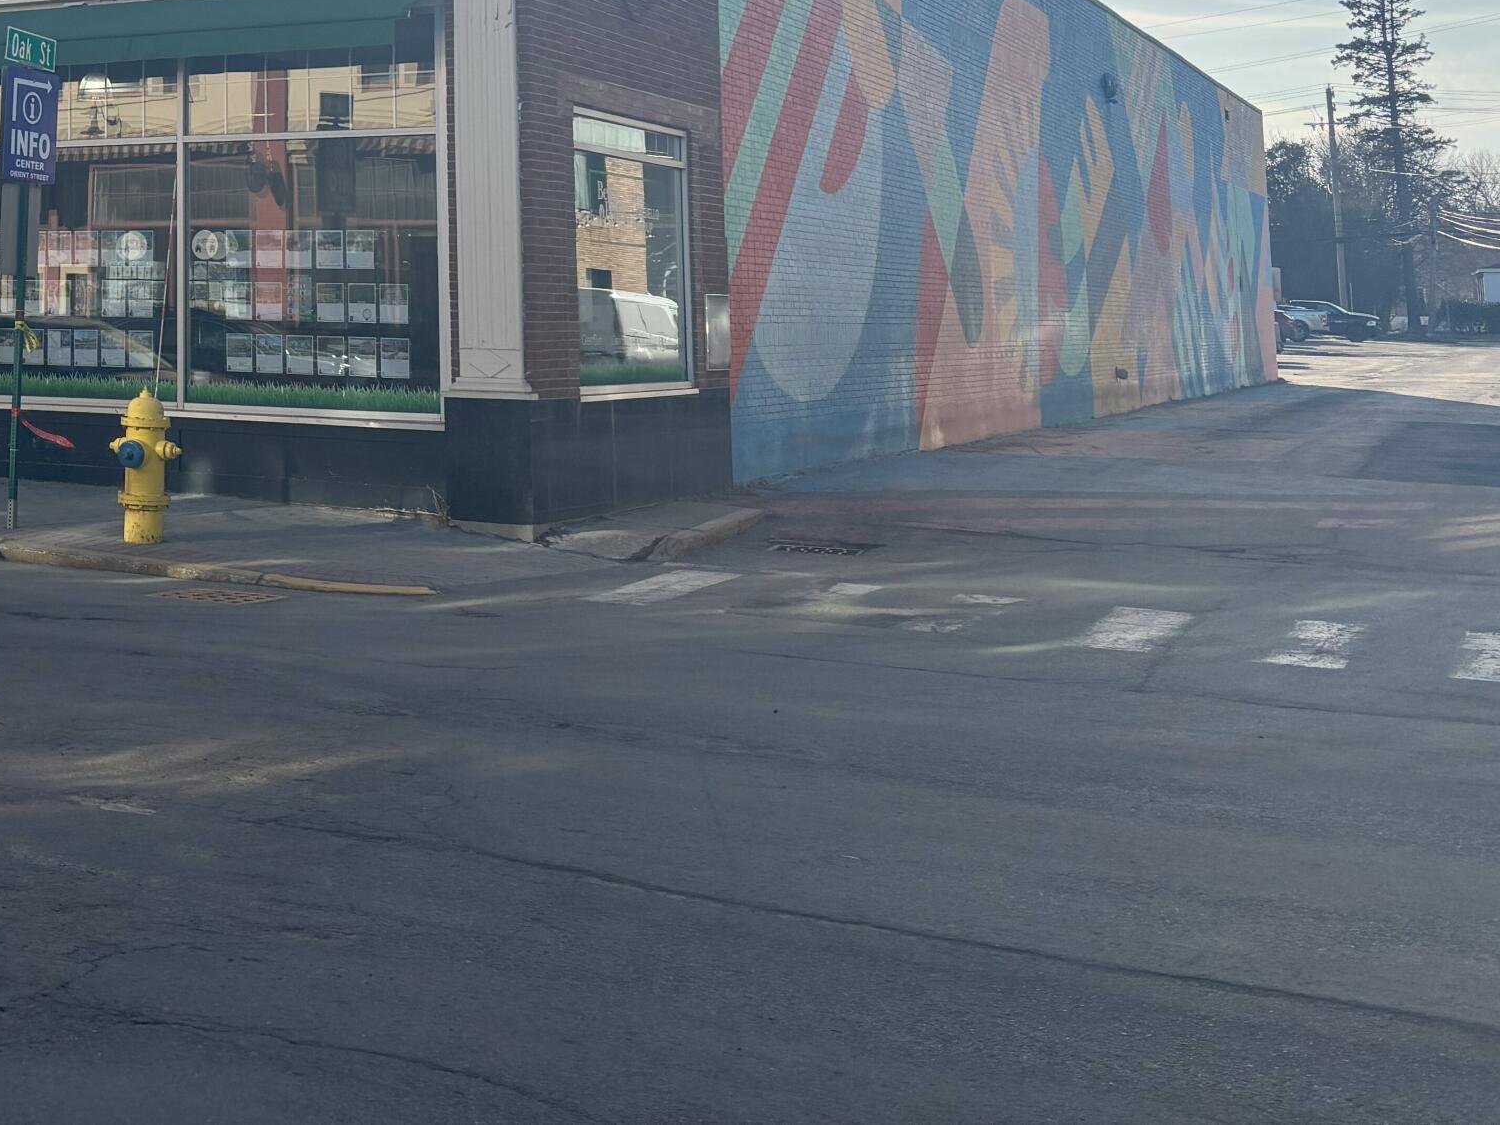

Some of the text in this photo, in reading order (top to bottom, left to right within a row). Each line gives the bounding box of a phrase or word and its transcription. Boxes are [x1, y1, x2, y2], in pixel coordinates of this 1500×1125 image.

[11, 33, 51, 66] Oak St
[10, 128, 51, 161] INFO
[10, 169, 49, 181] ORIENT STREET
[15, 158, 45, 172] CENTER
